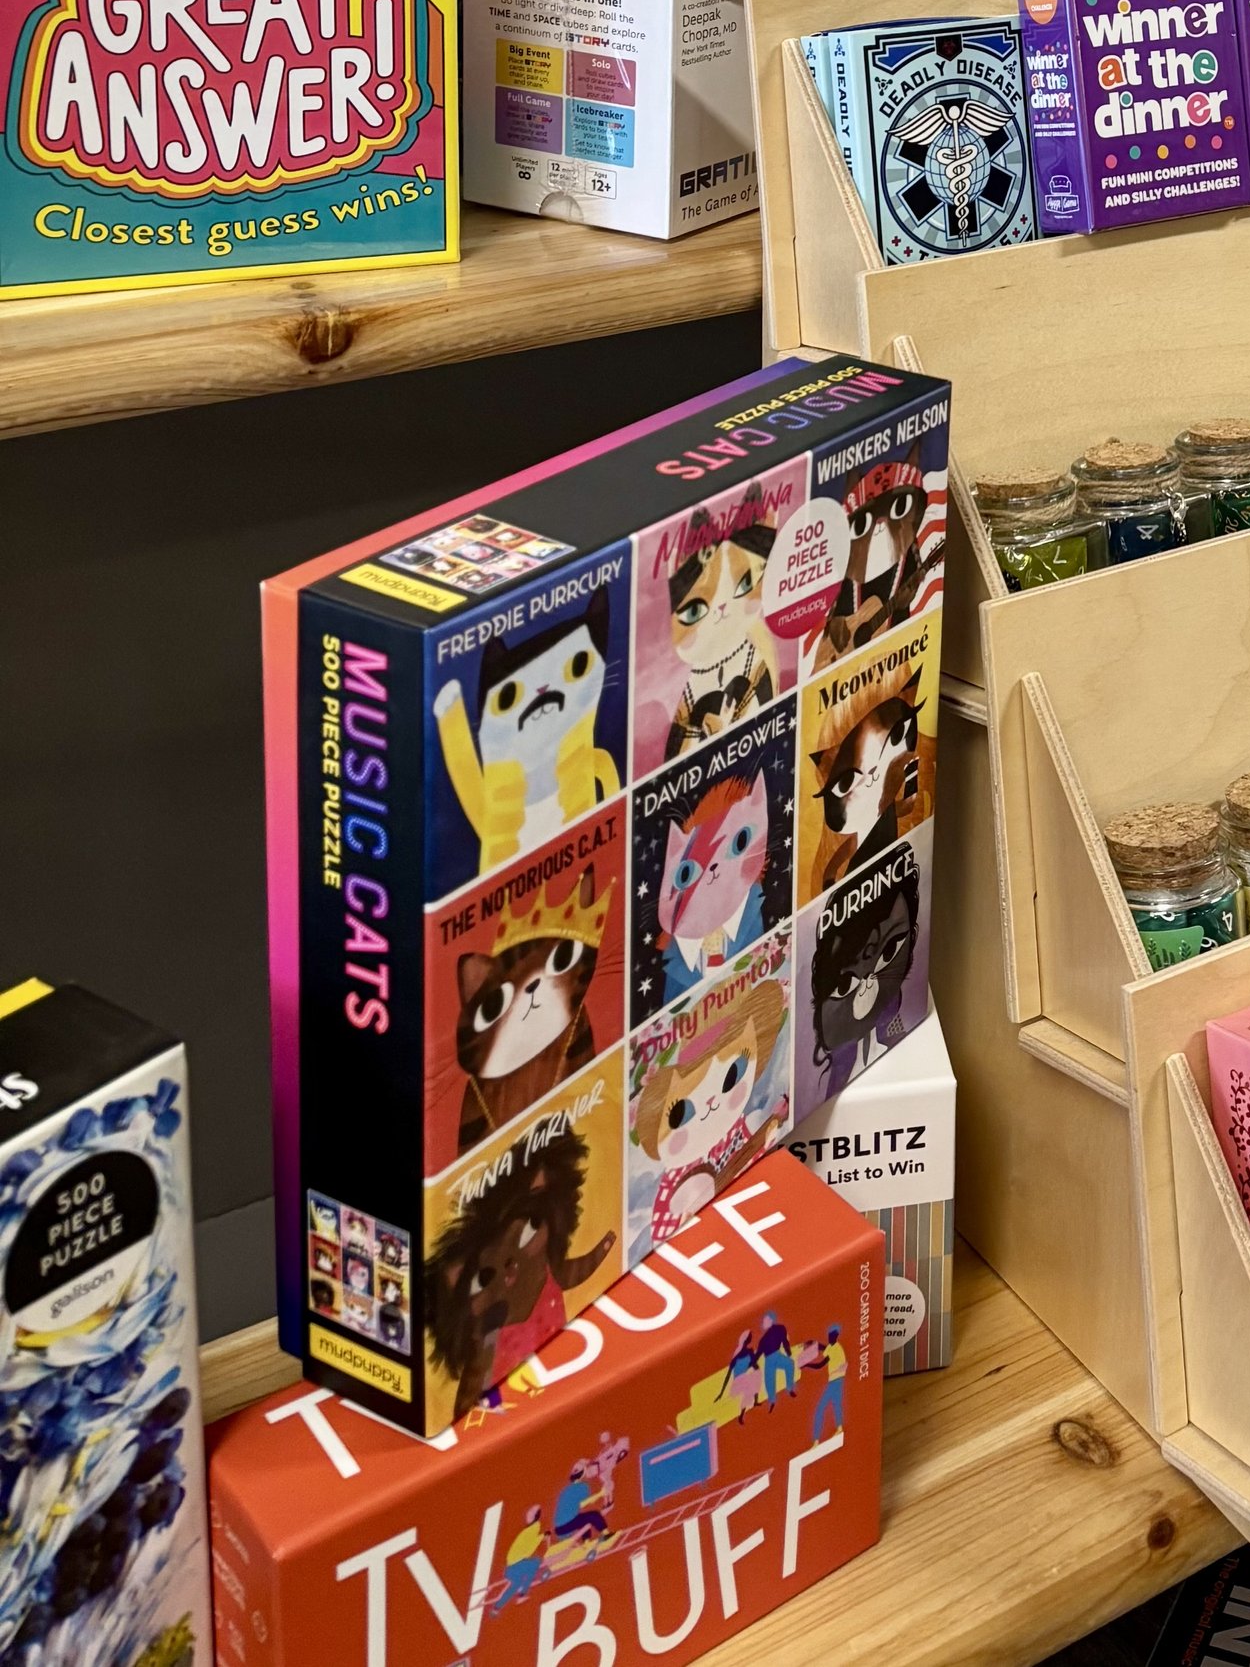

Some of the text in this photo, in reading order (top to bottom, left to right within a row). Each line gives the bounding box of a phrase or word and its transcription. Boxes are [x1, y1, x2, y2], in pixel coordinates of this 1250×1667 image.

[879, 58, 1023, 118] DEADLY DISEASE
[1097, 47, 1219, 91] at the
[576, 105, 625, 121] Icebreaker
[1094, 89, 1229, 139] dinner
[1101, 157, 1239, 190] FUN MINI COMPETITIONS
[1104, 175, 1241, 209] AND SILLY CHALLENGES!
[34, 164, 435, 257] Closest guess wins!
[816, 399, 949, 486] WHISKERS NELSON
[787, 539, 829, 572] PIECE
[794, 519, 825, 547] 500
[778, 558, 834, 597] PUZZLE
[436, 556, 625, 665] FREDDIE PURRCURY
[817, 624, 930, 716] Meowyoncé
[321, 633, 343, 890] 500 PIECE PUZZLE
[643, 710, 787, 819] DAVID MEOWIE
[342, 639, 390, 1035] MUSIC CATS
[440, 843, 575, 946] THE NOTORIOUS
[818, 850, 917, 938] PURRINCE
[56, 1172, 106, 1215] 500
[827, 1159, 925, 1185] List Win
[39, 1214, 124, 1277] PUZZLE
[47, 1193, 115, 1246] PIECE
[50, 1267, 115, 1320] galison
[859, 1291, 870, 1332] CARDS
[536, 1432, 845, 1667] BUFF
[337, 1501, 503, 1655] TV
